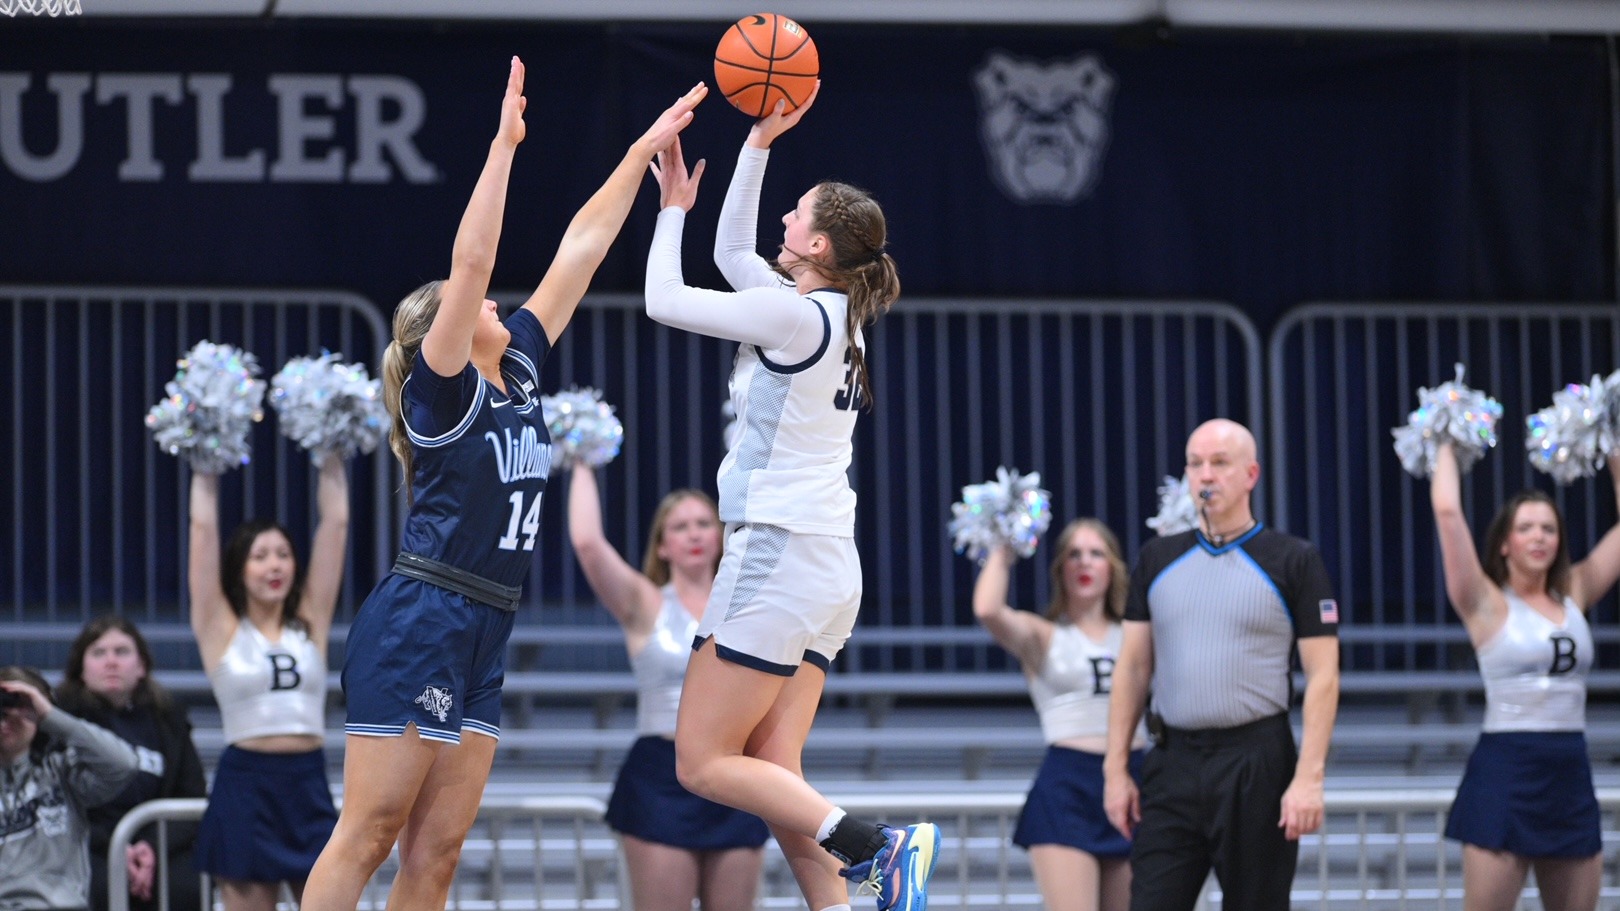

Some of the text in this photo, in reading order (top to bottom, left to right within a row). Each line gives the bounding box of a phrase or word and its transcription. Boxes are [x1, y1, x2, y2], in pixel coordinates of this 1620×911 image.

[0, 73, 439, 183] UTLER
[498, 490, 543, 551] 14
[267, 653, 302, 691] B
[1548, 636, 1577, 676] B
